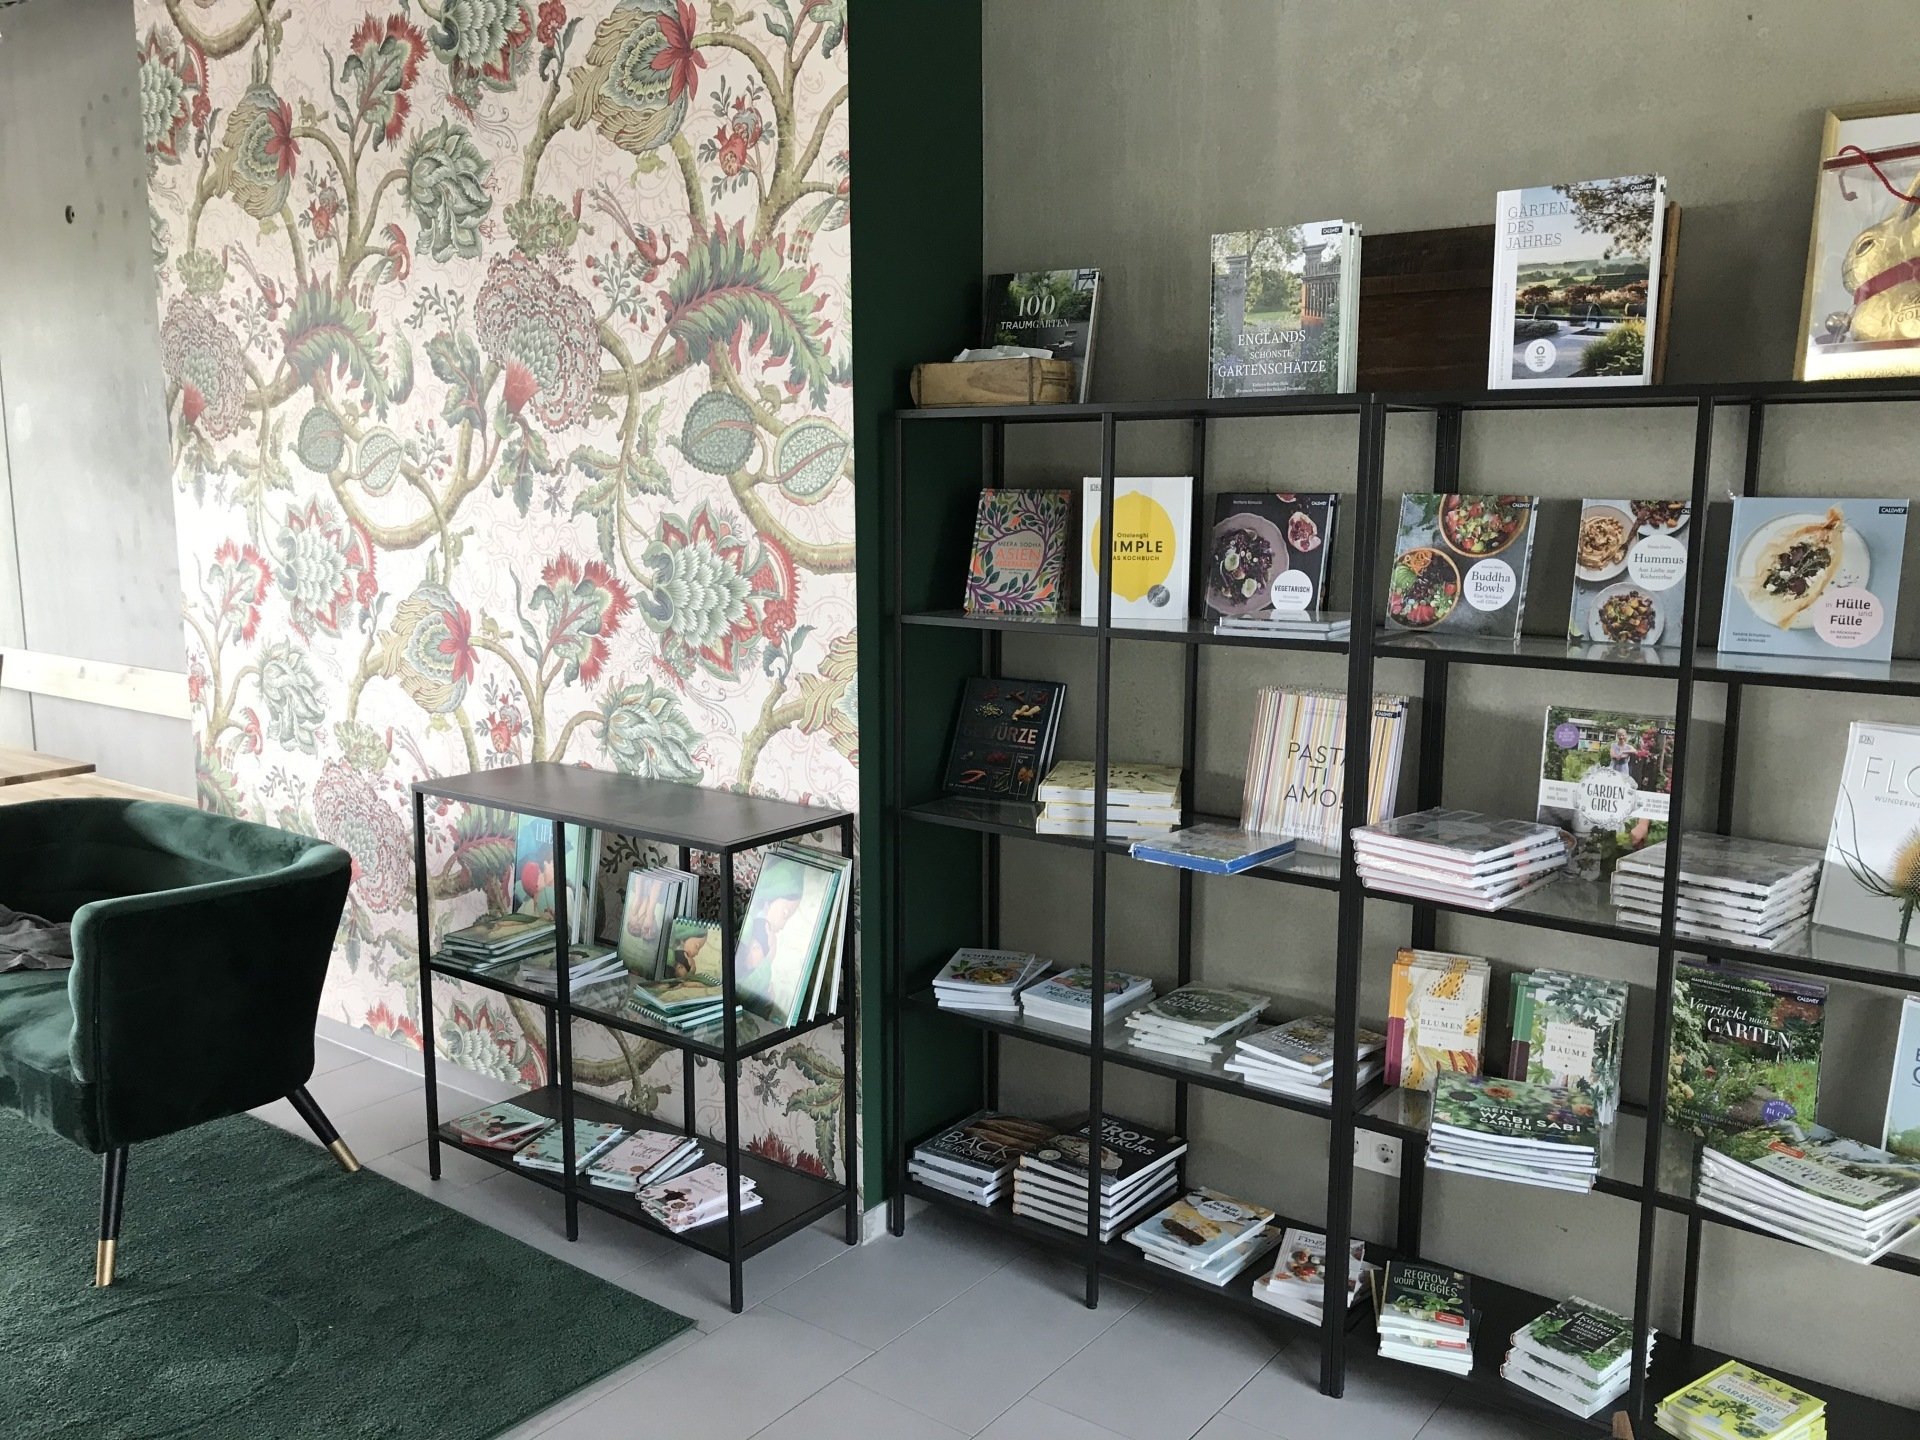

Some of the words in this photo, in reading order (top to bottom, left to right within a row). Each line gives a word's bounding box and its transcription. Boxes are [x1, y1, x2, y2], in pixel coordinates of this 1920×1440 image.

[1507, 220, 1534, 234] DES
[1506, 232, 1562, 250] JAHRES
[1018, 294, 1056, 316] 100
[1238, 329, 1306, 346] ENGLANDS
[1218, 360, 1327, 378] GARTENSCHÄTZE
[996, 548, 1041, 560] ASIEN
[1113, 540, 1163, 552] IMPLE
[1634, 554, 1684, 564] Hummus
[1472, 570, 1511, 582] Buddha
[1274, 584, 1310, 592] VEGETARISCH
[1474, 582, 1505, 593] Bowls
[1836, 598, 1871, 610] Hülle
[1830, 614, 1862, 626] Fülle
[984, 722, 1038, 745] ÜRZE
[1288, 742, 1345, 766] PAST
[1309, 766, 1328, 785] TI
[1284, 784, 1344, 810] AMO
[1586, 783, 1626, 800] GARDEN
[1591, 798, 1618, 814] GIRLS
[1689, 996, 1748, 1021] Verrückt
[1748, 1016, 1770, 1026] nach
[1420, 1018, 1463, 1030] BLUMEN
[1708, 1018, 1791, 1049] GARTEN
[1480, 1106, 1514, 1116] MEIN
[1480, 1111, 1530, 1126] WABI
[1537, 1120, 1580, 1132] SABI
[1480, 1118, 1532, 1131] GARTEN
[942, 1131, 1008, 1158] BACK
[1404, 1268, 1448, 1286] REGROW
[1418, 1280, 1458, 1298] VEGGIES
[1717, 1384, 1778, 1414] GARANTIERT
